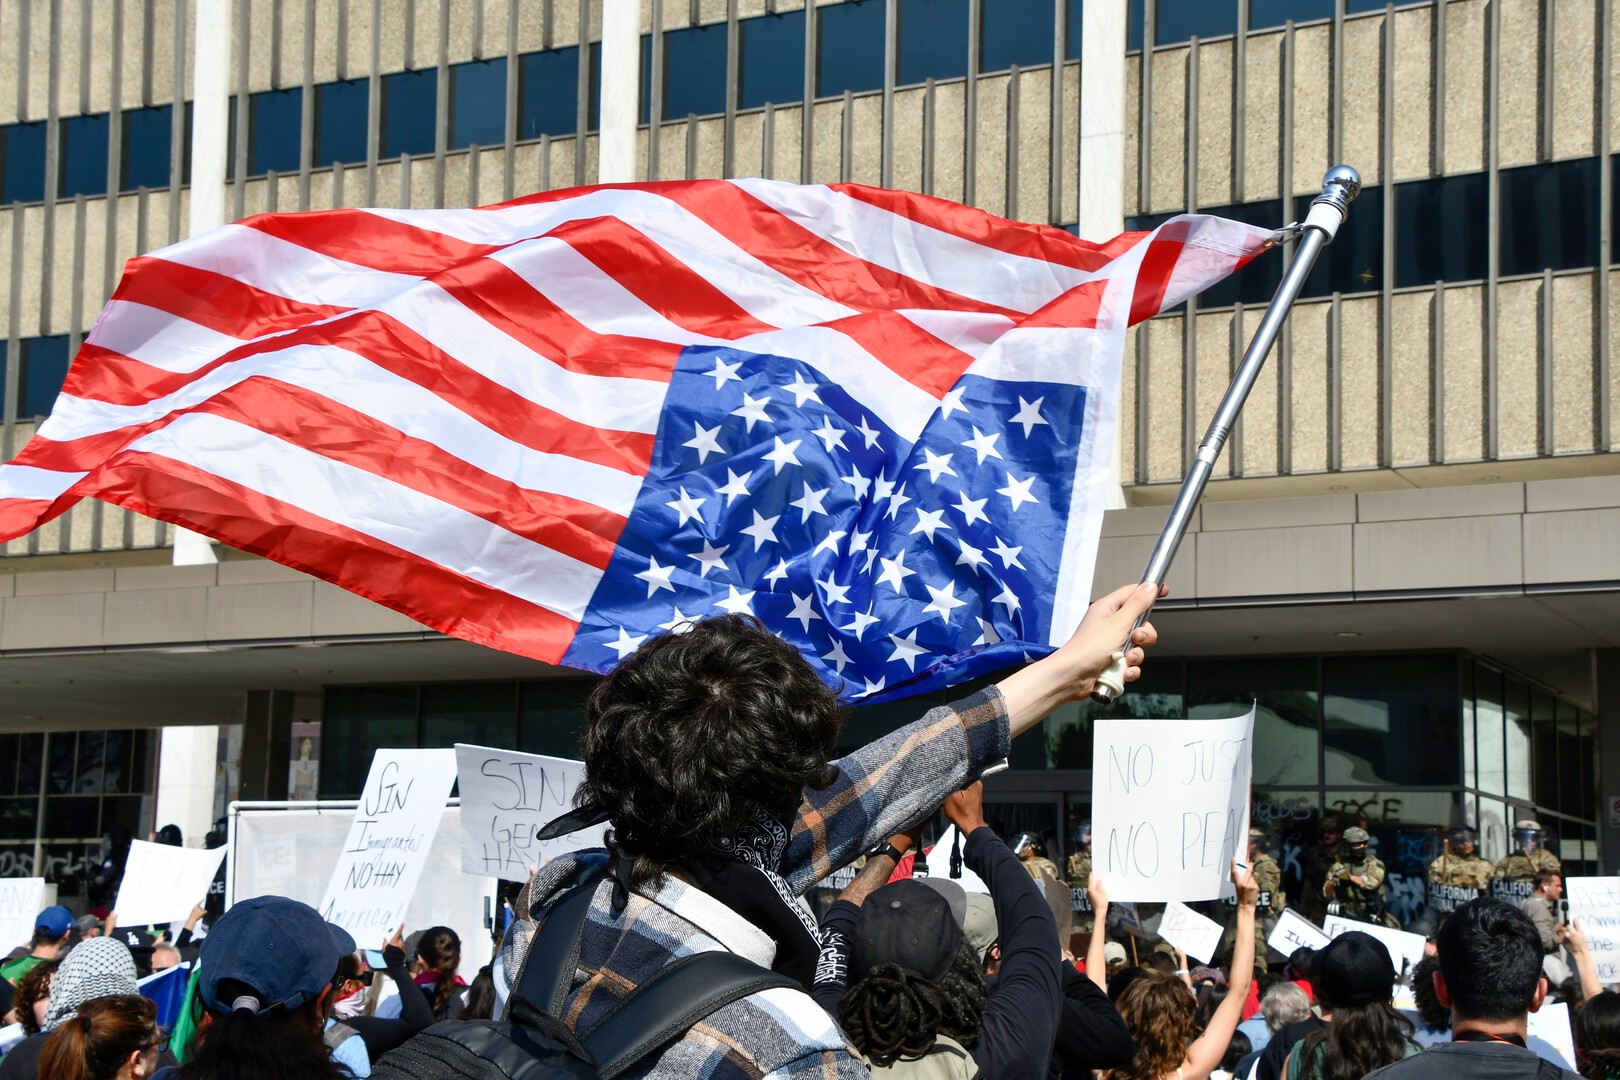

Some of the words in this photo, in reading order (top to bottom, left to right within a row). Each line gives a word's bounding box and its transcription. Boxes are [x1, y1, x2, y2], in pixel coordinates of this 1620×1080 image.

[365, 761, 415, 817] SIN
[480, 758, 567, 812] SIN
[1108, 743, 1155, 794] NO
[1108, 821, 1160, 878] NO
[345, 861, 373, 890] NO
[373, 861, 407, 889] HAY
[126, 931, 140, 945] LA
[322, 898, 404, 933] America!
